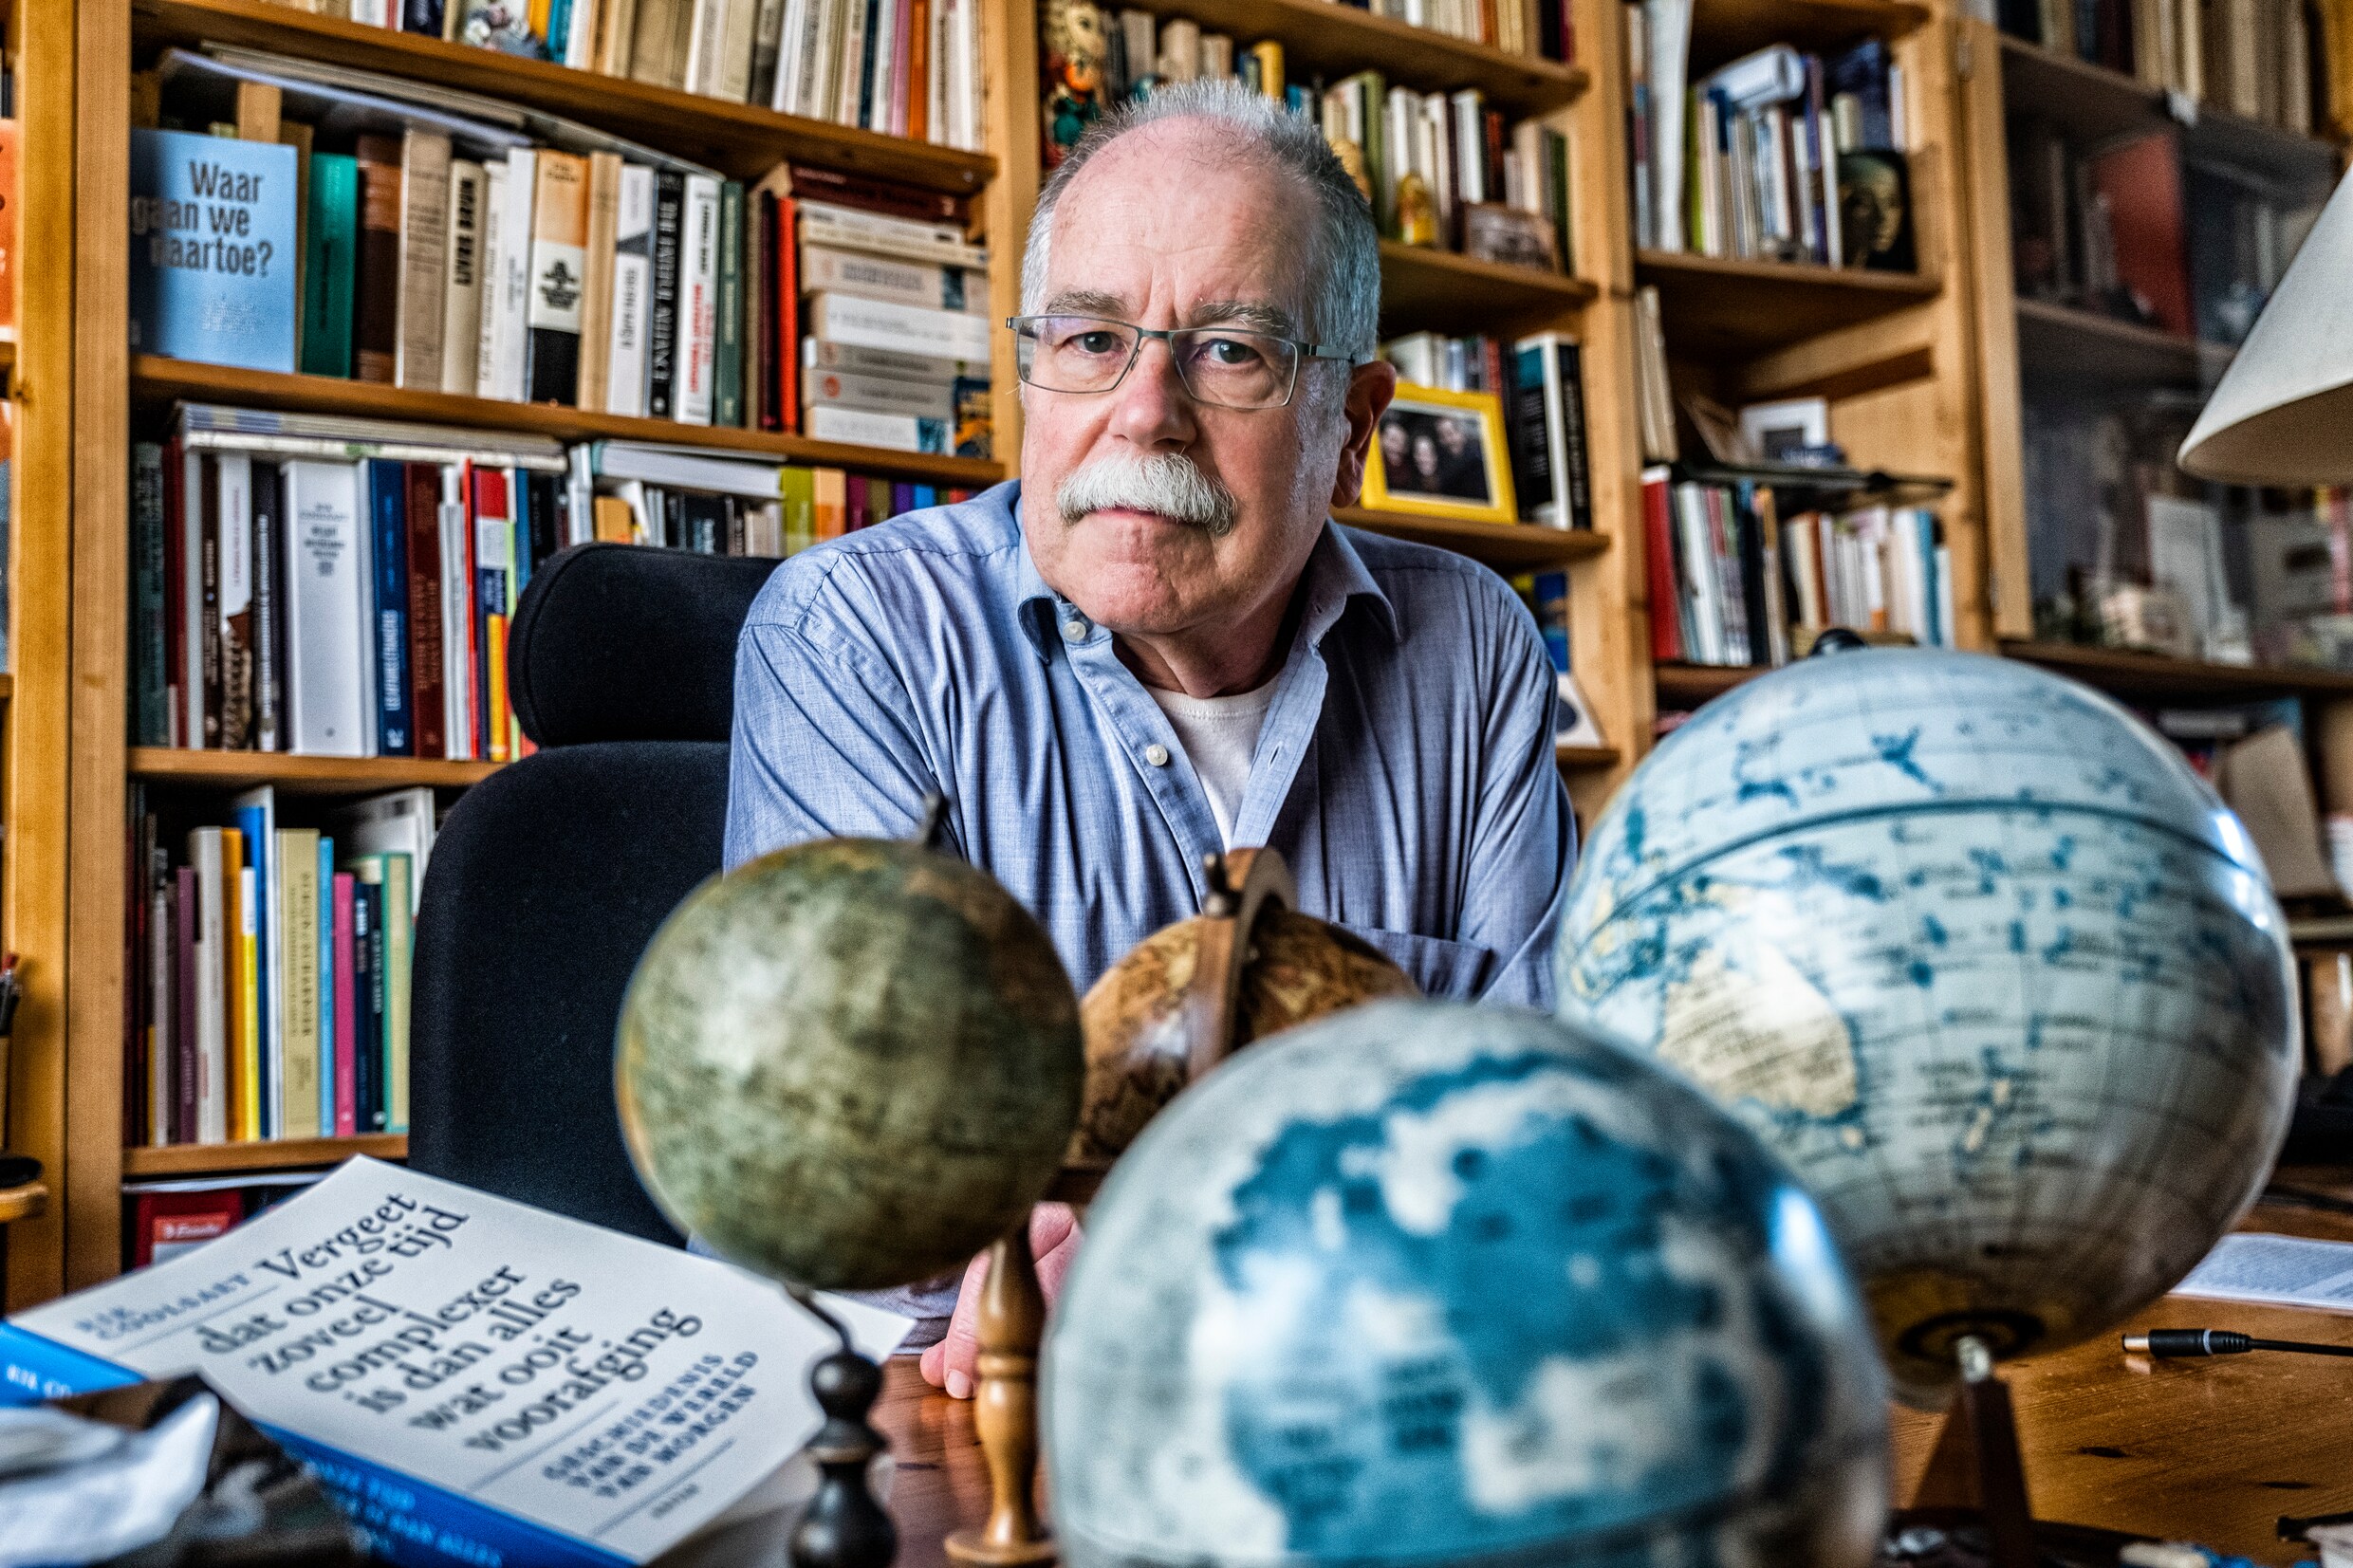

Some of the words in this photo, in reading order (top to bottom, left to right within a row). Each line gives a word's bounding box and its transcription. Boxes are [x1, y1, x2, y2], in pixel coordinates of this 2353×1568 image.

[132, 195, 199, 236] gaan
[209, 204, 250, 237] we
[189, 161, 263, 204] Waar
[196, 1311, 287, 1355] dat
[286, 1259, 395, 1317] onze
[389, 1206, 471, 1259] tijd
[255, 1192, 417, 1281] Vergeet
[247, 1293, 401, 1374] zoveel
[306, 1264, 526, 1393] complexer
[343, 1389, 407, 1415] is
[397, 1340, 495, 1391] dan
[487, 1279, 582, 1342] alles
[408, 1383, 507, 1430] wat
[498, 1325, 593, 1385] ooit
[464, 1307, 703, 1452] voorafging
[542, 1353, 723, 1481] GESCHIEDENIS
[568, 1455, 626, 1488] VAN
[623, 1430, 664, 1455] DE
[660, 1351, 758, 1424] WERELD
[594, 1465, 653, 1498] VAN
[652, 1384, 756, 1464] MORGEN
